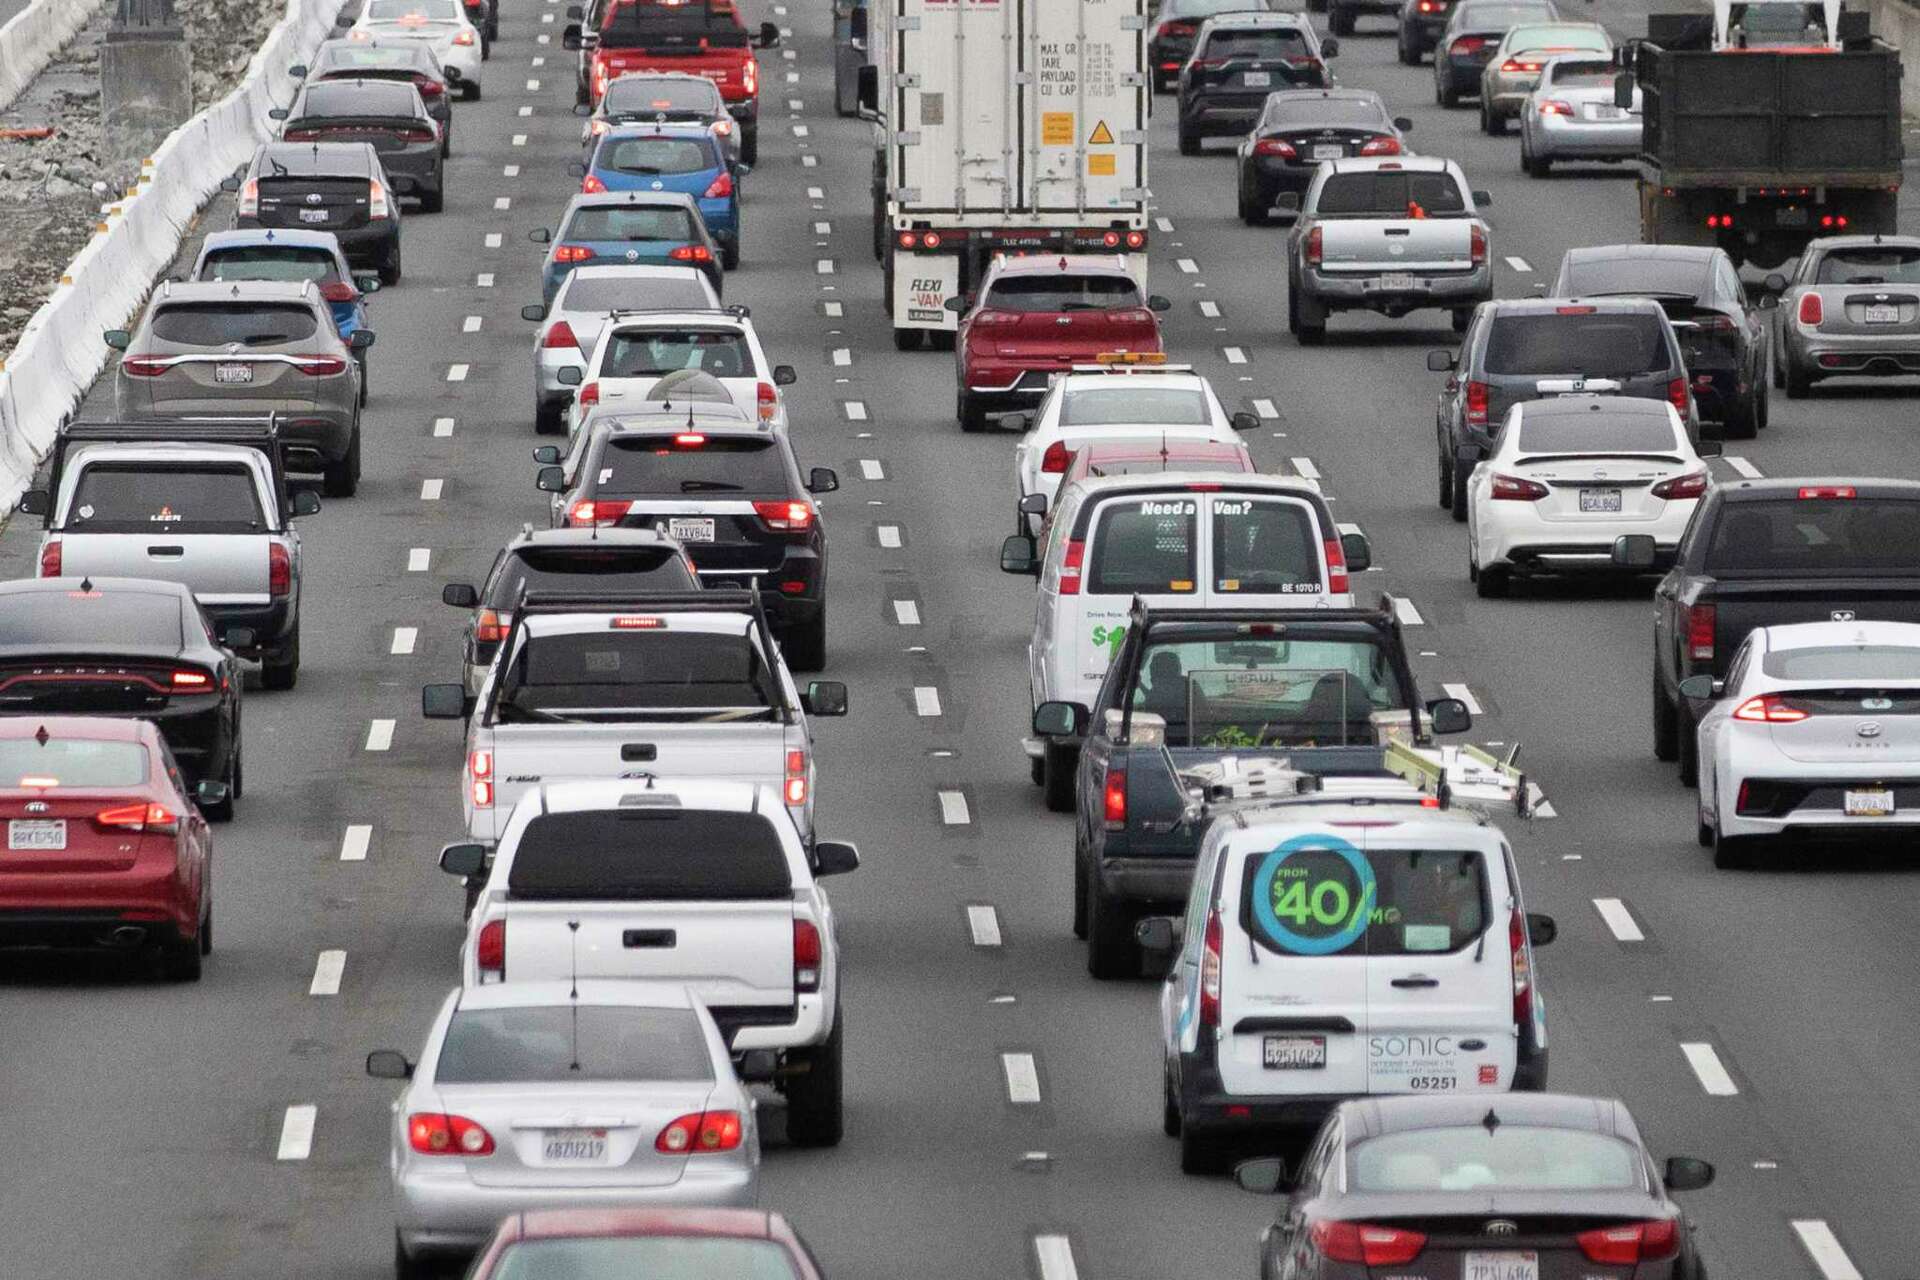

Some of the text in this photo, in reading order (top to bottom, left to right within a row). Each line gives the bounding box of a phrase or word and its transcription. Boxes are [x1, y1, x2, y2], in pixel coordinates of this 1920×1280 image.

[1041, 43, 1077, 55] MAX GR
[1041, 57, 1061, 69] TARE
[1041, 71, 1076, 82] PAYLOAD
[1041, 84, 1077, 96] CU CAP
[911, 279, 943, 291] FLEXI
[1141, 501, 1252, 515] Need a Van?
[1281, 583, 1293, 593] BE
[1295, 583, 1313, 593] 1070
[1277, 867, 1309, 878] FROM
[1411, 1076, 1457, 1089] 05251
